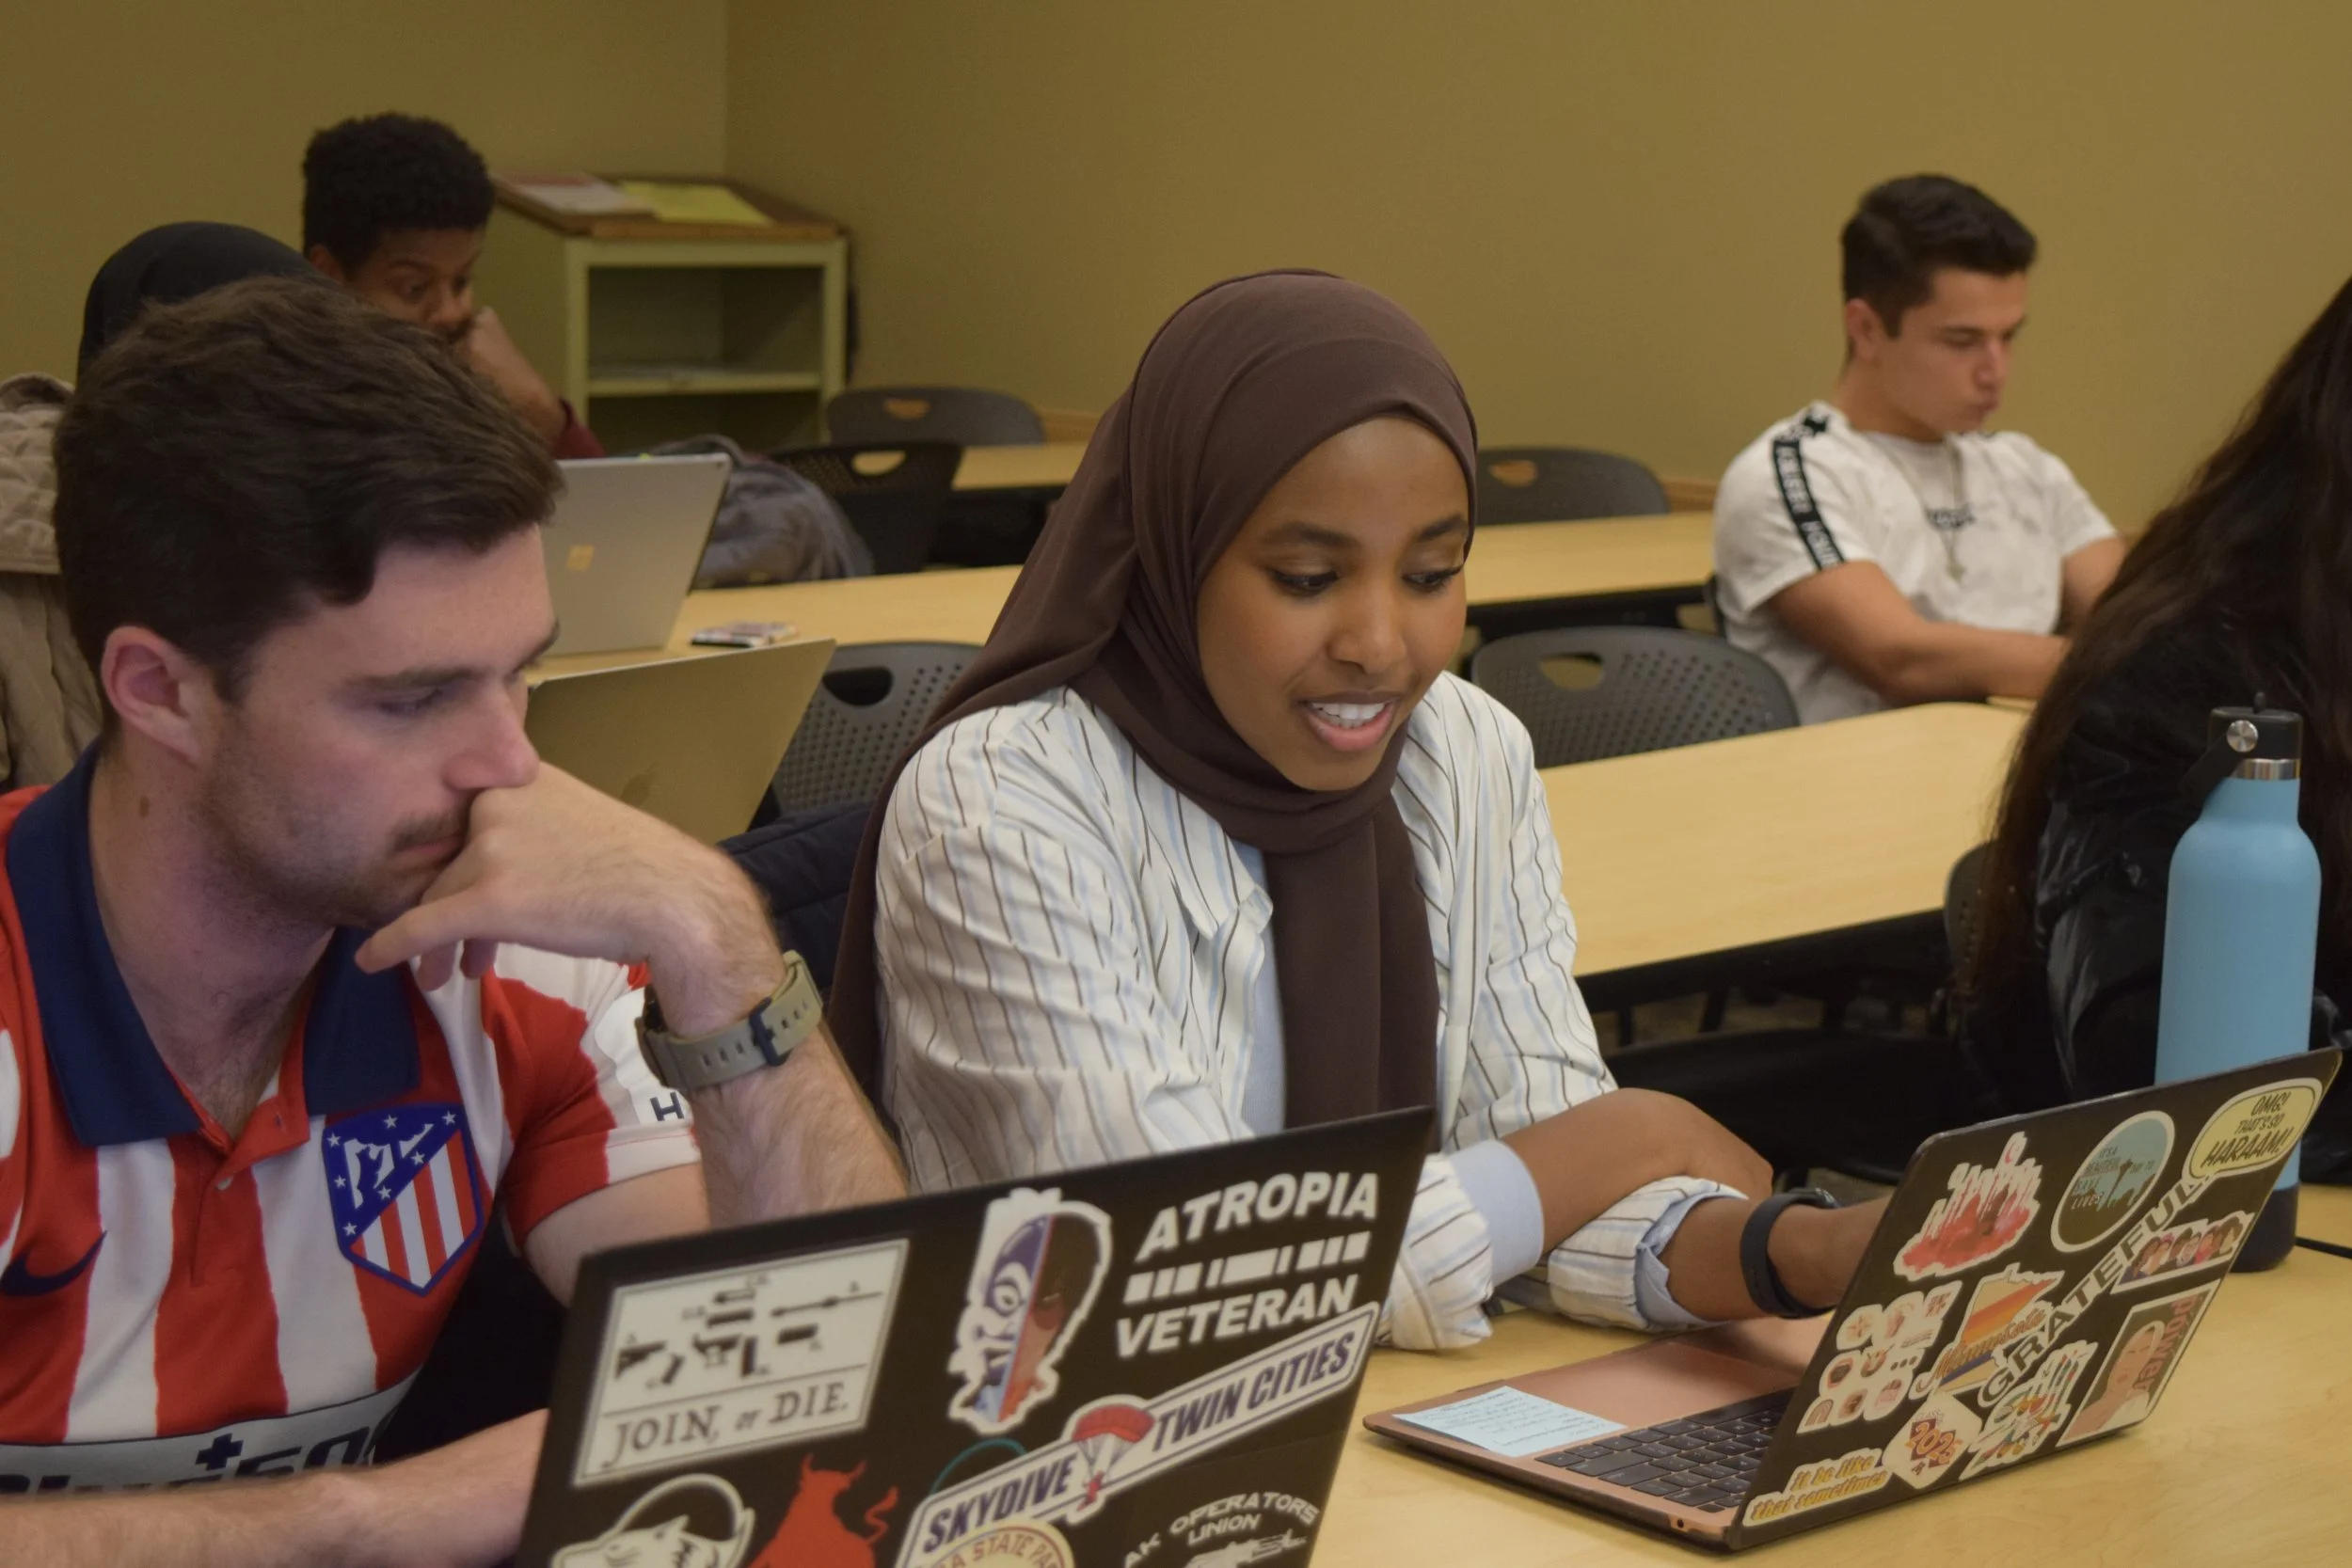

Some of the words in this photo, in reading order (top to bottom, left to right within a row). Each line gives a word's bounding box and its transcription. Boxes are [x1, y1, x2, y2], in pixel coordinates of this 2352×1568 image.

[2234, 1117, 2271, 1135] THAT'S
[2267, 1114, 2285, 1129] SO
[2250, 1091, 2291, 1117] OMG!
[2200, 1127, 2295, 1168] HARAAM!
[1134, 1172, 1377, 1263] ATROPIA
[1117, 1275, 1359, 1358] VETERAN
[923, 1453, 1079, 1554] SKYDIVE
[1152, 1380, 1245, 1453] TWIN
[1247, 1332, 1355, 1411] CITIES
[1904, 1421, 1963, 1465] 2025
[1168, 1491, 1320, 1535] OPERATORS
[1187, 1513, 1263, 1545] UNION
[972, 1533, 1034, 1561] STATE
